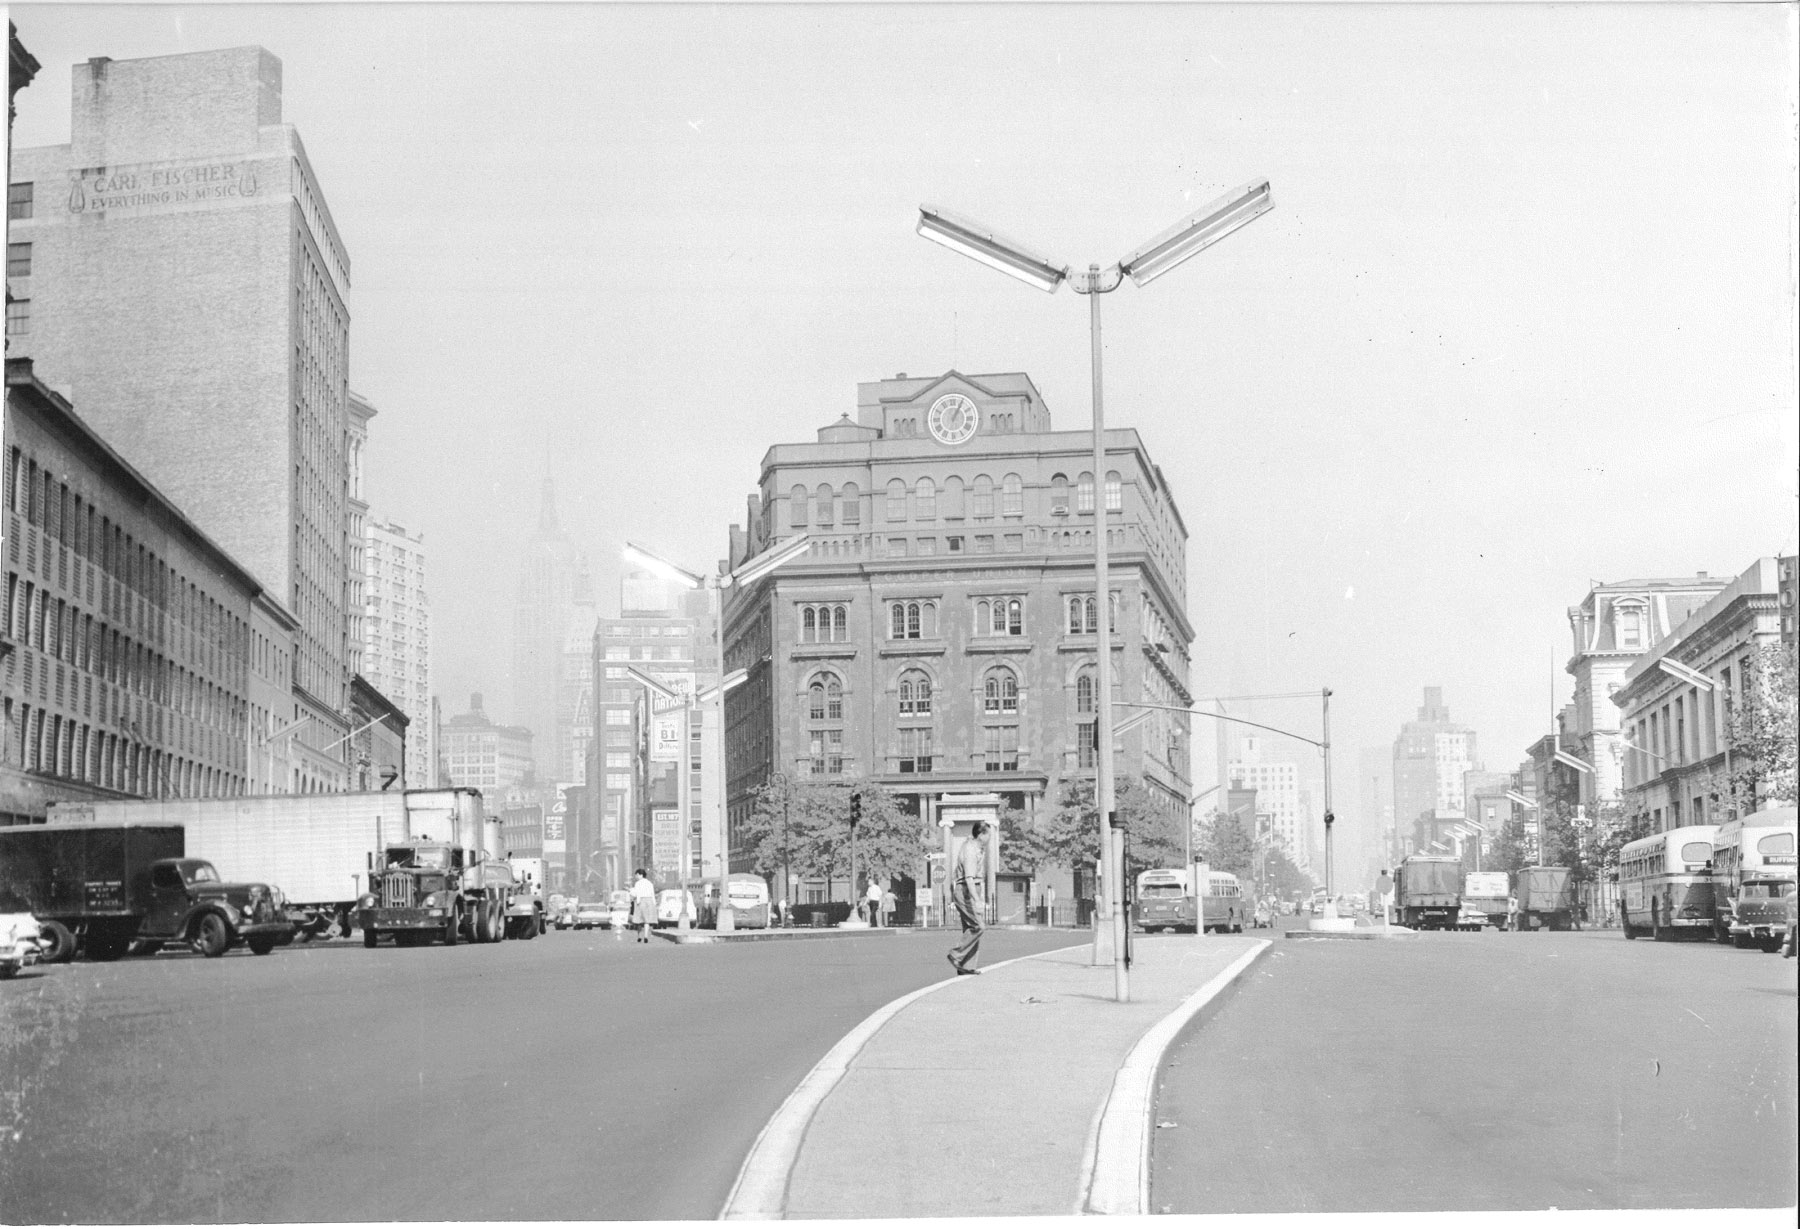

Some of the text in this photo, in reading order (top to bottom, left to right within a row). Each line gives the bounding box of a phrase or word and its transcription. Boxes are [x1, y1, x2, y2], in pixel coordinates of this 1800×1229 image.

[94, 164, 235, 193] CARL FISCHER
[91, 191, 169, 210] EVERYTHING
[175, 189, 189, 202] IN
[884, 568, 1027, 581] COOPER UNION
[1779, 562, 1797, 634] HOT
[933, 870, 946, 878] STOP
